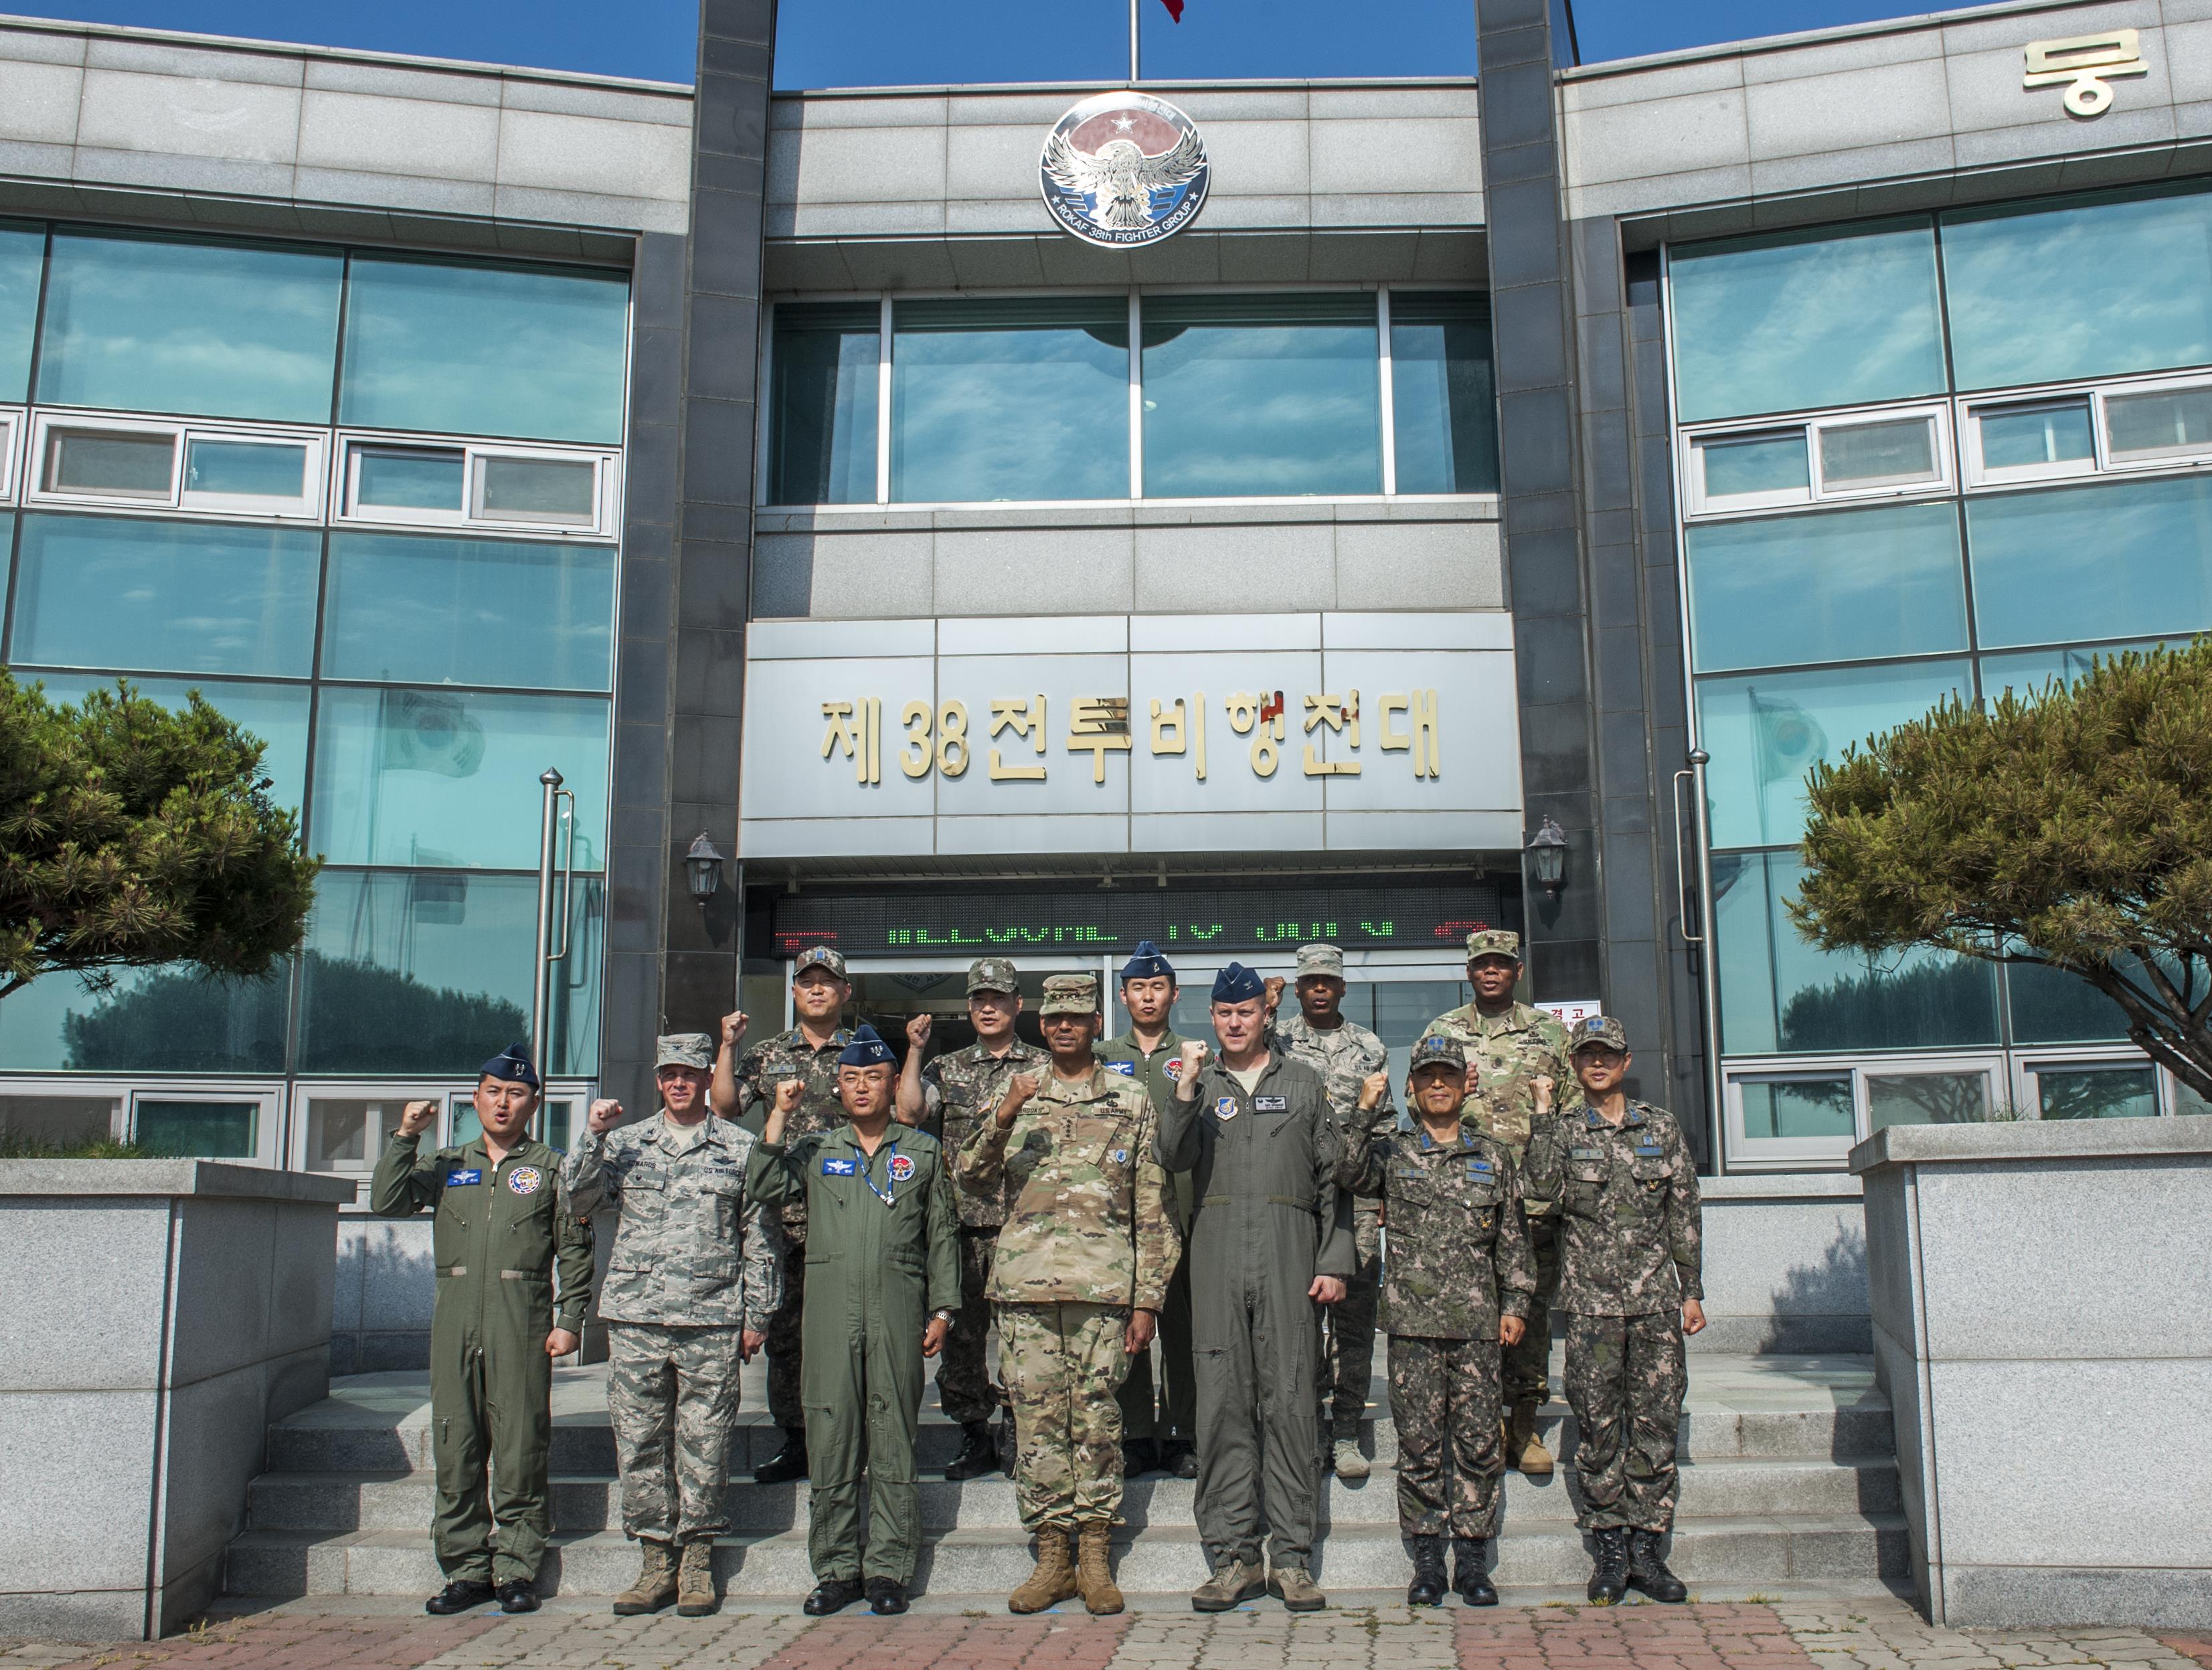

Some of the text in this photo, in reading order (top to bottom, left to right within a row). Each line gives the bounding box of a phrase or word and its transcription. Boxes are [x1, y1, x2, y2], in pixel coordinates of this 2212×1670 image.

[2023, 29, 2149, 116] 동
[1057, 201, 1191, 242] ROKAF 38th FIGHTER GROUP
